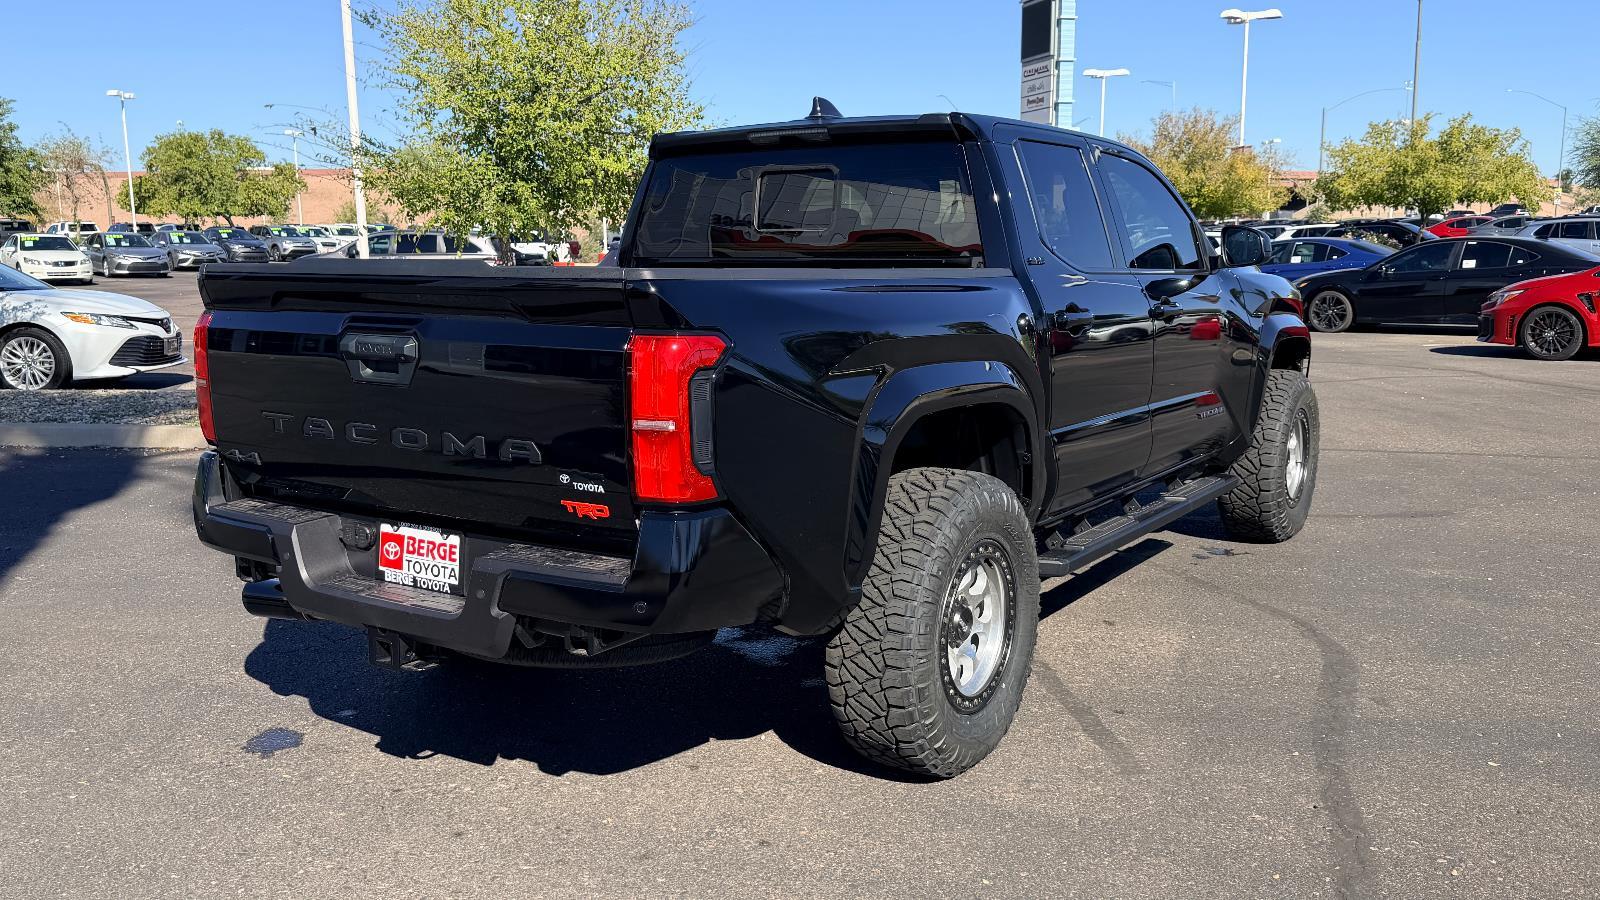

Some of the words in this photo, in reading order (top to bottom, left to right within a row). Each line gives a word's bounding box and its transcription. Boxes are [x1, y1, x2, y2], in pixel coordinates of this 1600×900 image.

[1023, 65, 1049, 77] CINEMARK
[356, 343, 392, 354] TOYOTA
[261, 411, 542, 464] TACOMA
[572, 481, 605, 494] TOYOTA
[560, 499, 610, 520] TRD
[405, 535, 458, 563] BERGE
[405, 559, 458, 581] TOYOTA
[384, 569, 414, 586] BERGE
[415, 576, 451, 594] TOYOTA
